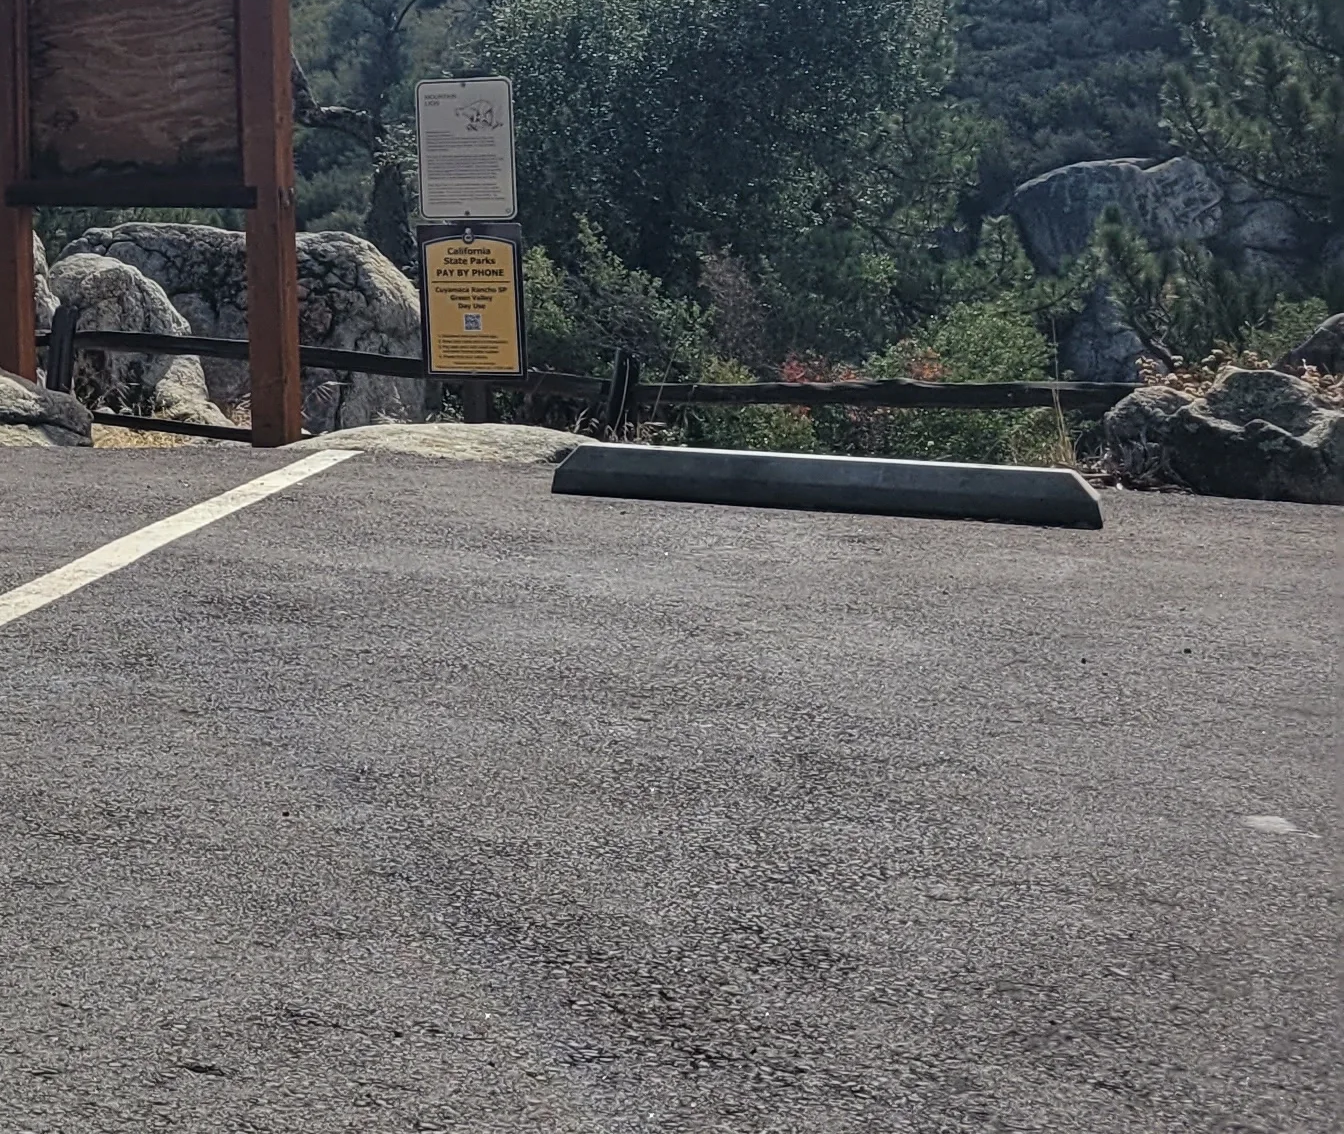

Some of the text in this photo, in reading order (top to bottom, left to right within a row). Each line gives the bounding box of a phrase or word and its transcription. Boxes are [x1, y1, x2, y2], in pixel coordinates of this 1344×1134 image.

[447, 247, 491, 255] California
[443, 257, 496, 265] State Parks
[436, 269, 454, 277] PAY
[457, 269, 469, 277] BY
